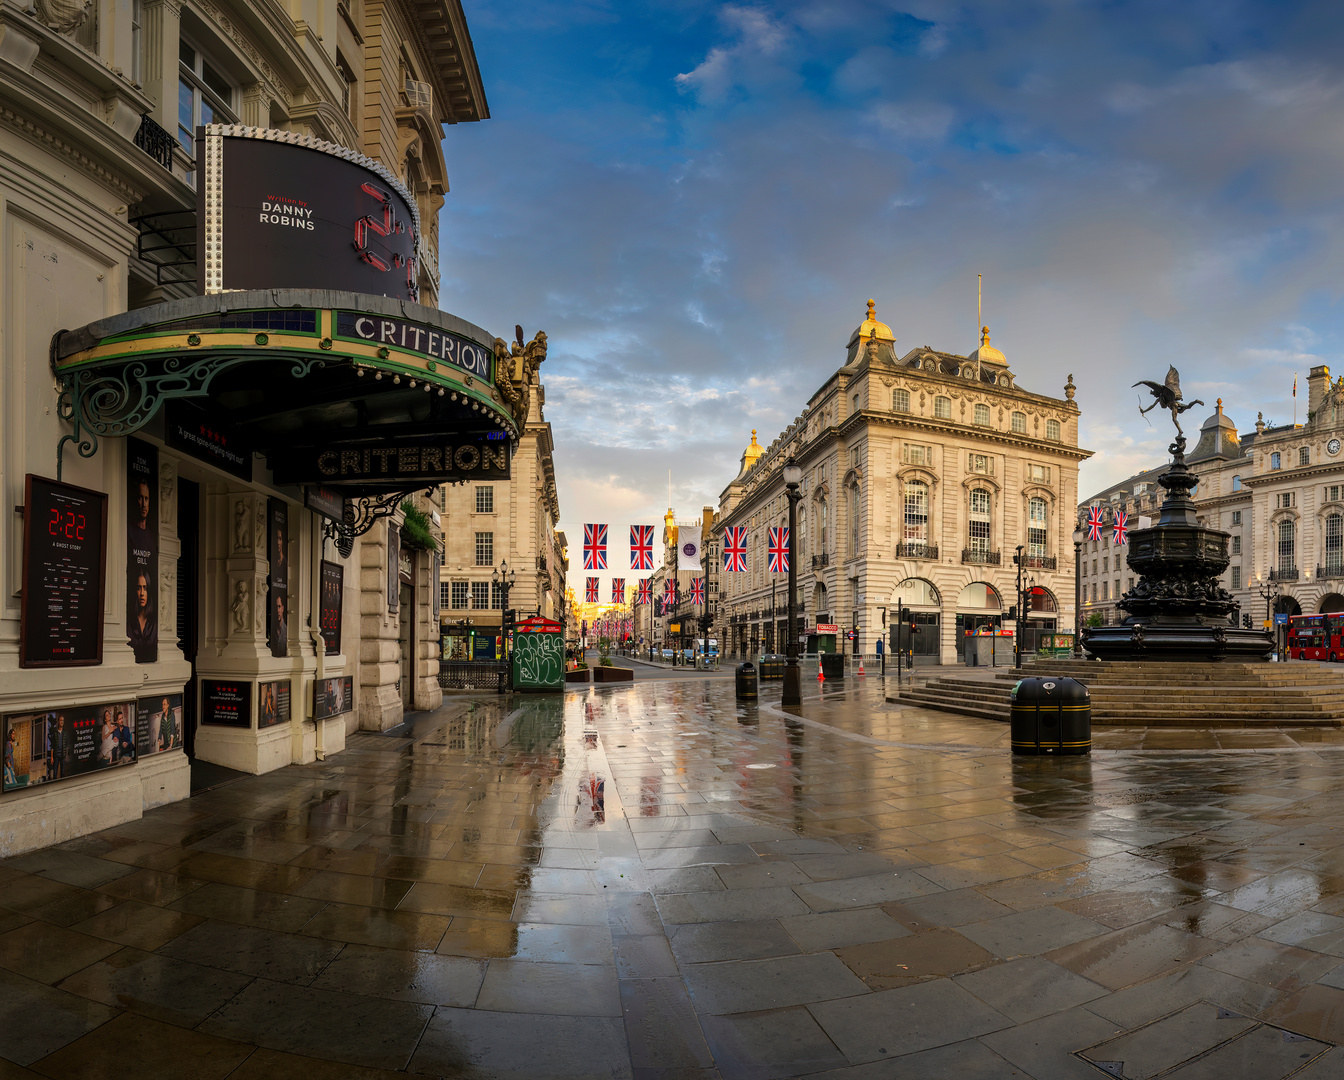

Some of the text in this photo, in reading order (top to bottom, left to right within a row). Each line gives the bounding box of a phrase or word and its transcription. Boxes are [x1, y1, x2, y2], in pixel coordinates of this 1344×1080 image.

[267, 194, 296, 204] Written
[262, 202, 312, 218] DANNY
[260, 213, 315, 230] ROBINS
[355, 318, 487, 376] CRITERION
[183, 430, 196, 442] great
[225, 450, 235, 461] night
[133, 462, 150, 474] FELTON
[137, 457, 147, 465] TOM
[318, 445, 506, 475] CRITERION
[49, 508, 86, 540] 2:22
[133, 549, 151, 558] MANDIP
[137, 556, 148, 565] GILL
[323, 609, 338, 629] 2:22
